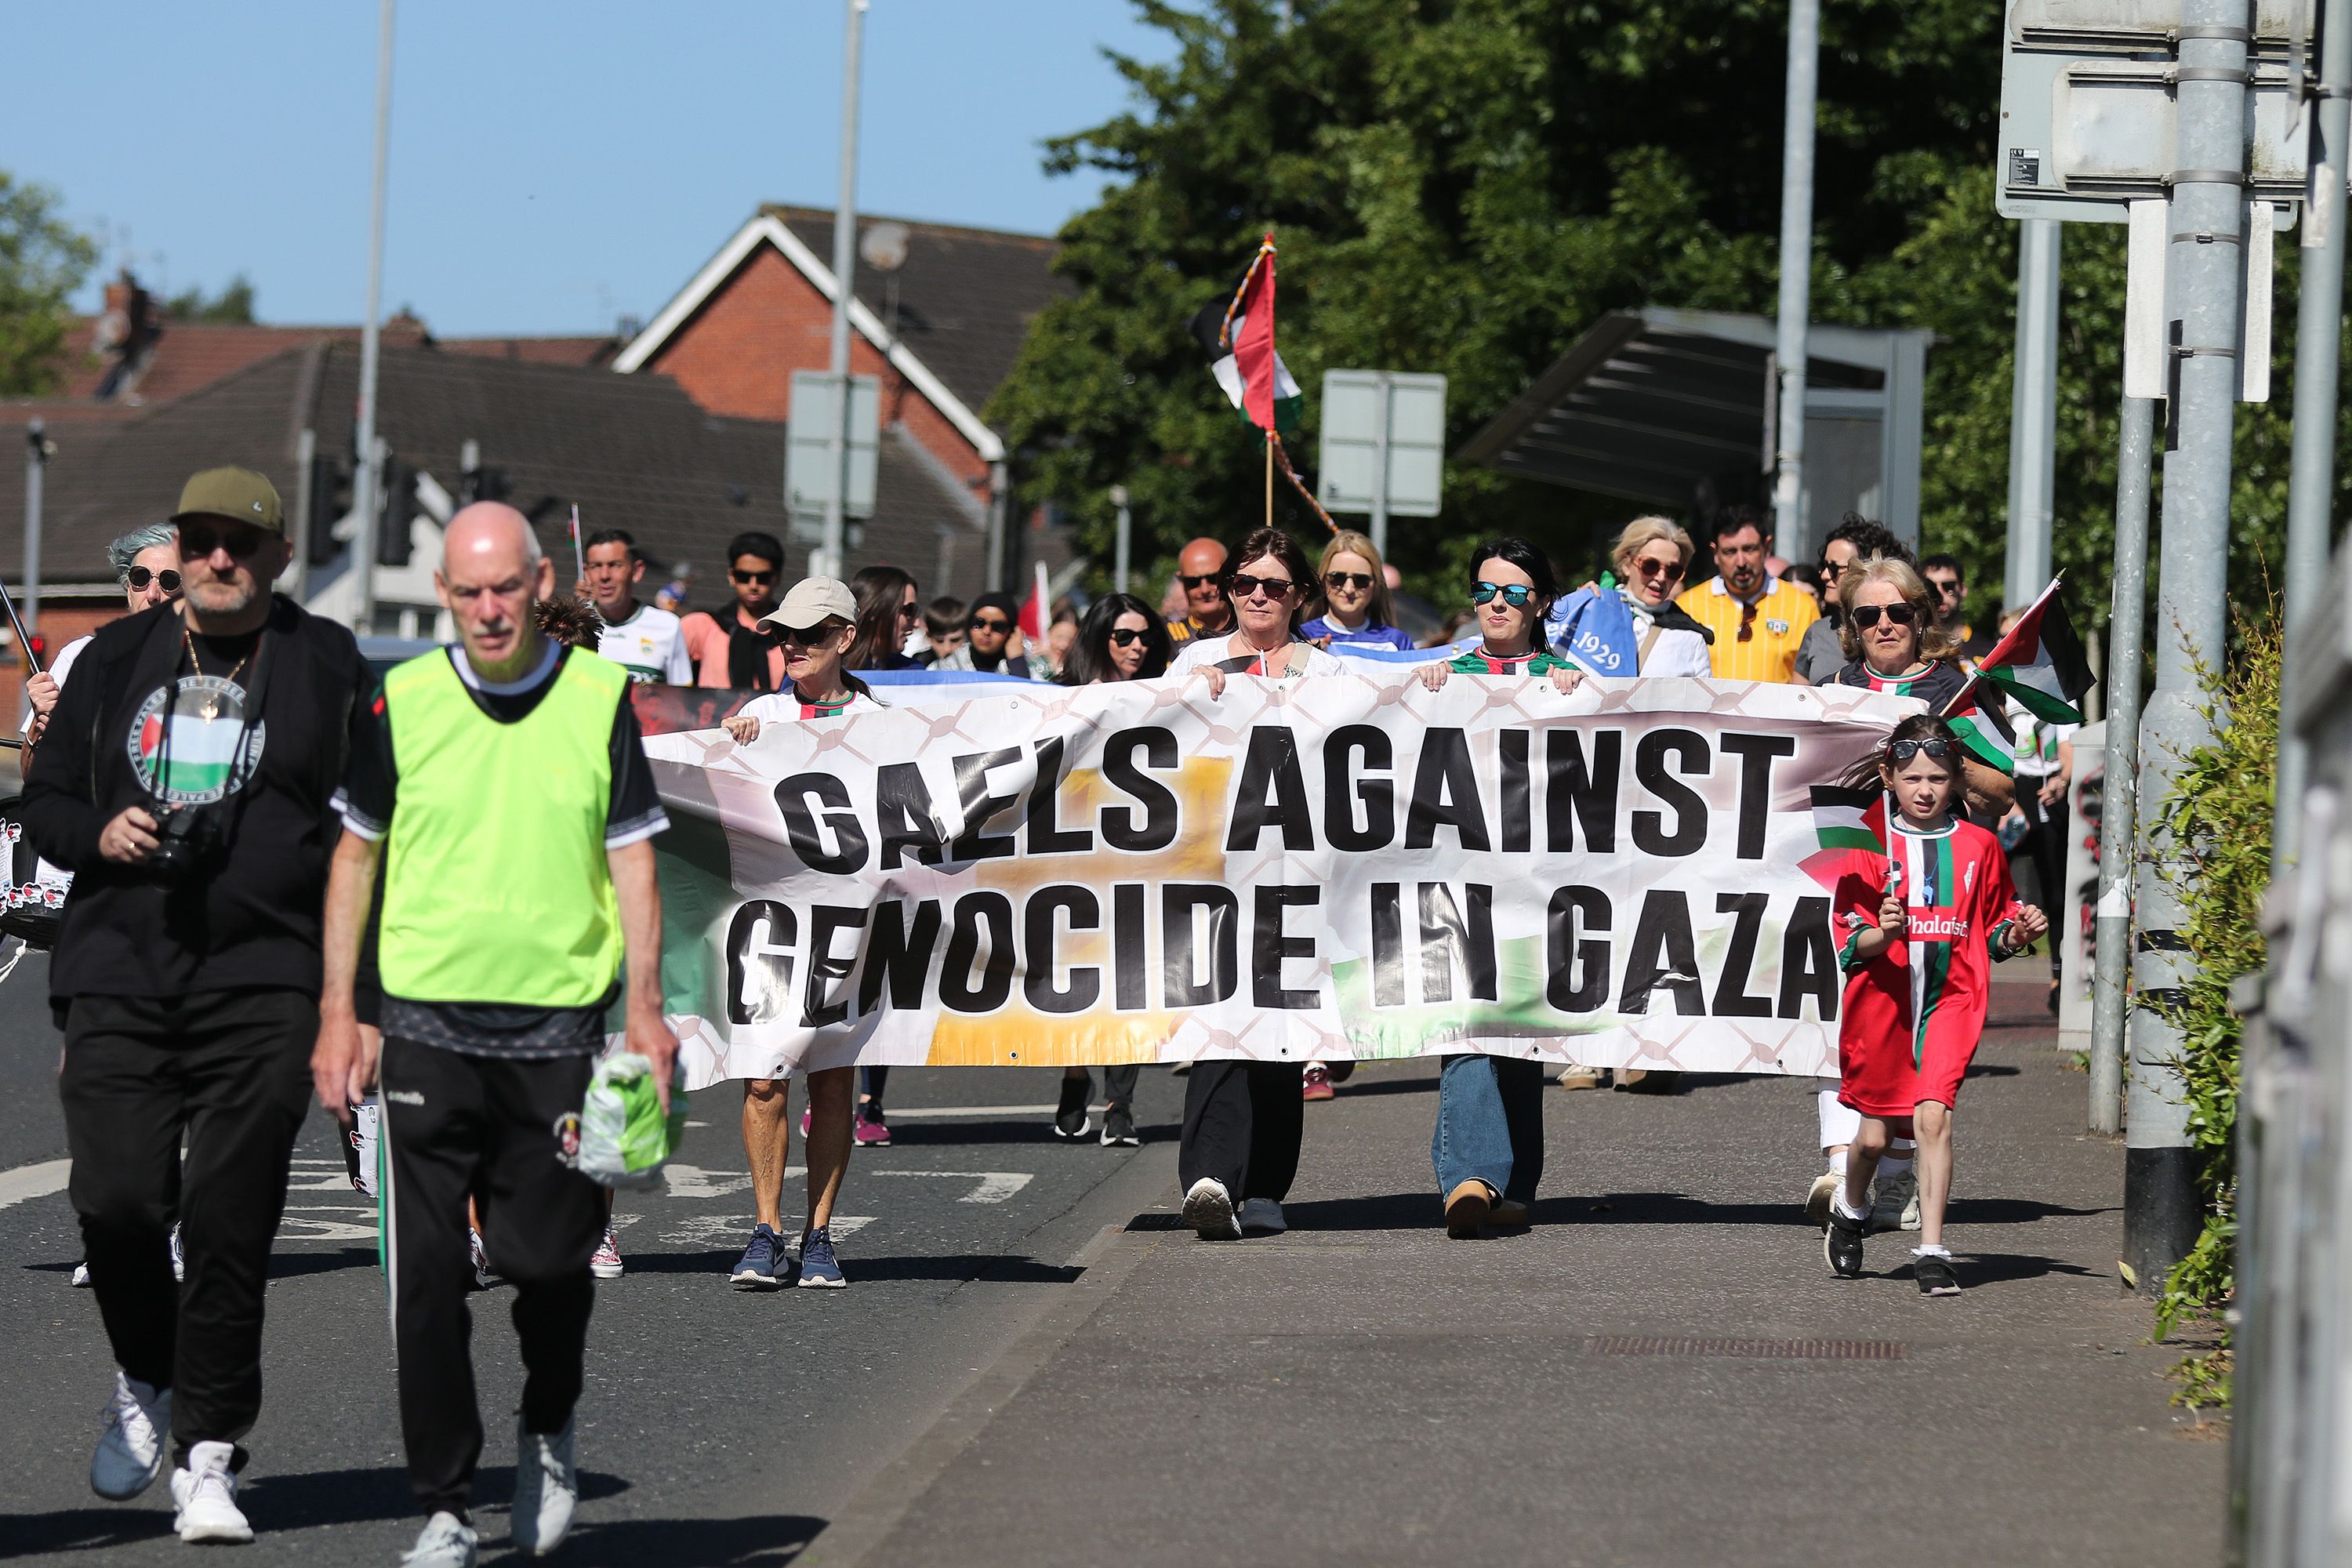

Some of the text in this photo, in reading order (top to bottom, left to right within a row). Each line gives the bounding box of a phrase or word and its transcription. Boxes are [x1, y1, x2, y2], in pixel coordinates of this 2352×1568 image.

[773, 724, 1795, 875] GAELS AGAINST
[726, 882, 1838, 1027] GENOCIDE IN GAZA
